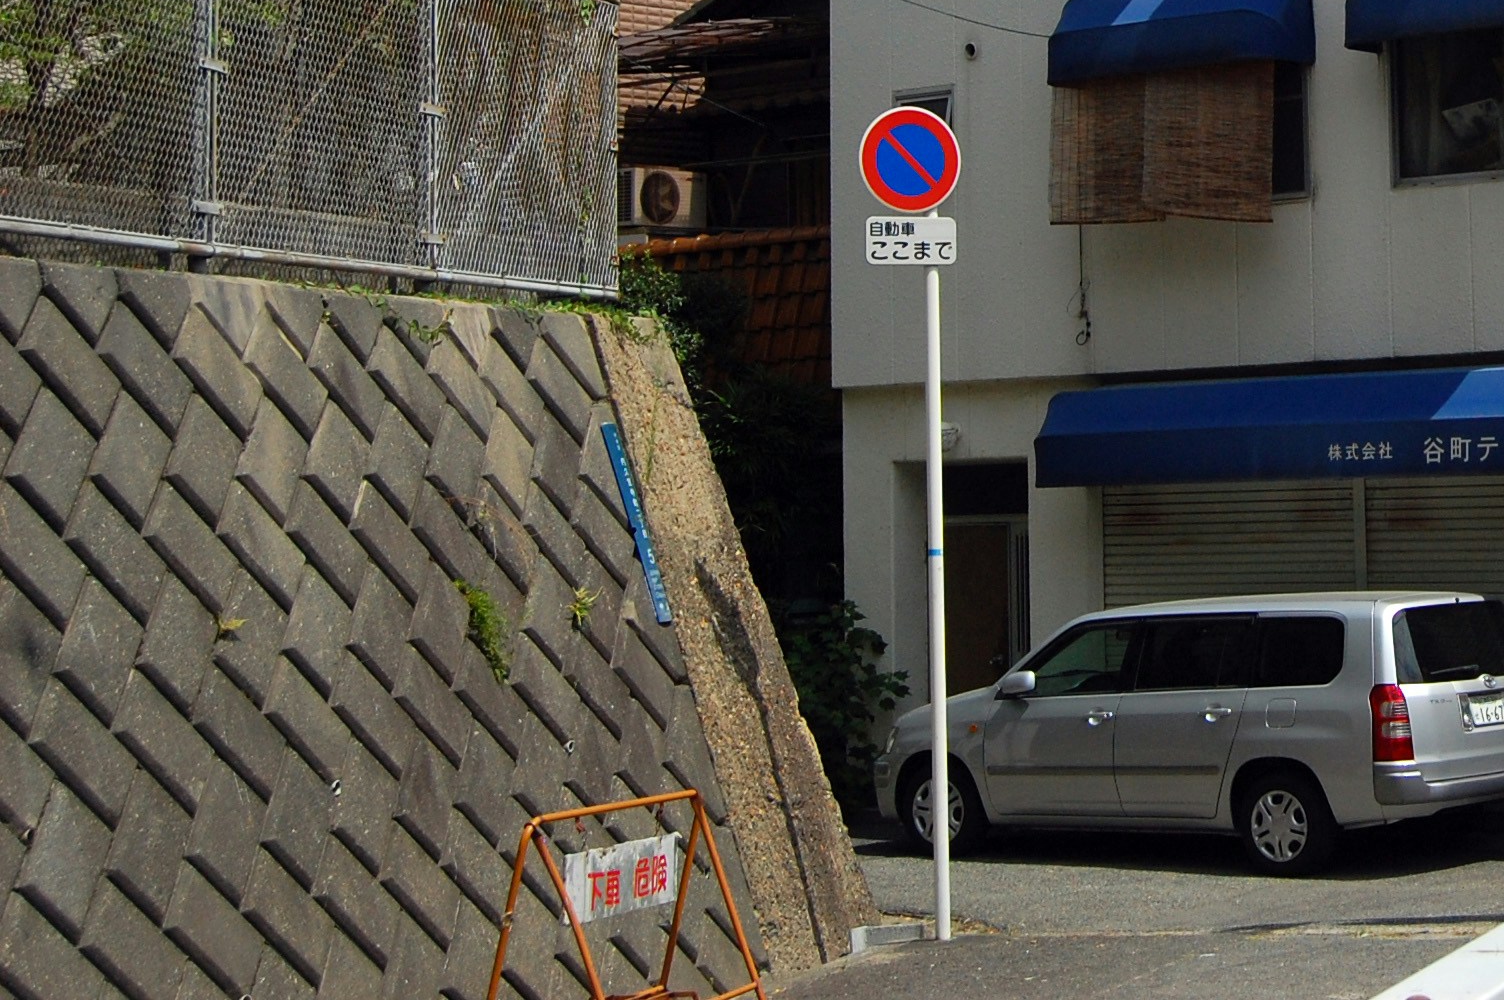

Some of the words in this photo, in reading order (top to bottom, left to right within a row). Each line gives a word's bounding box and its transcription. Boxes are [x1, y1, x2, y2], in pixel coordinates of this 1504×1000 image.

[869, 221, 916, 237] 自動車
[870, 240, 953, 261] ここまで
[1327, 441, 1394, 462] 株式会社
[646, 548, 656, 565] 5
[587, 868, 622, 911] 下車
[633, 853, 668, 898] 危険
